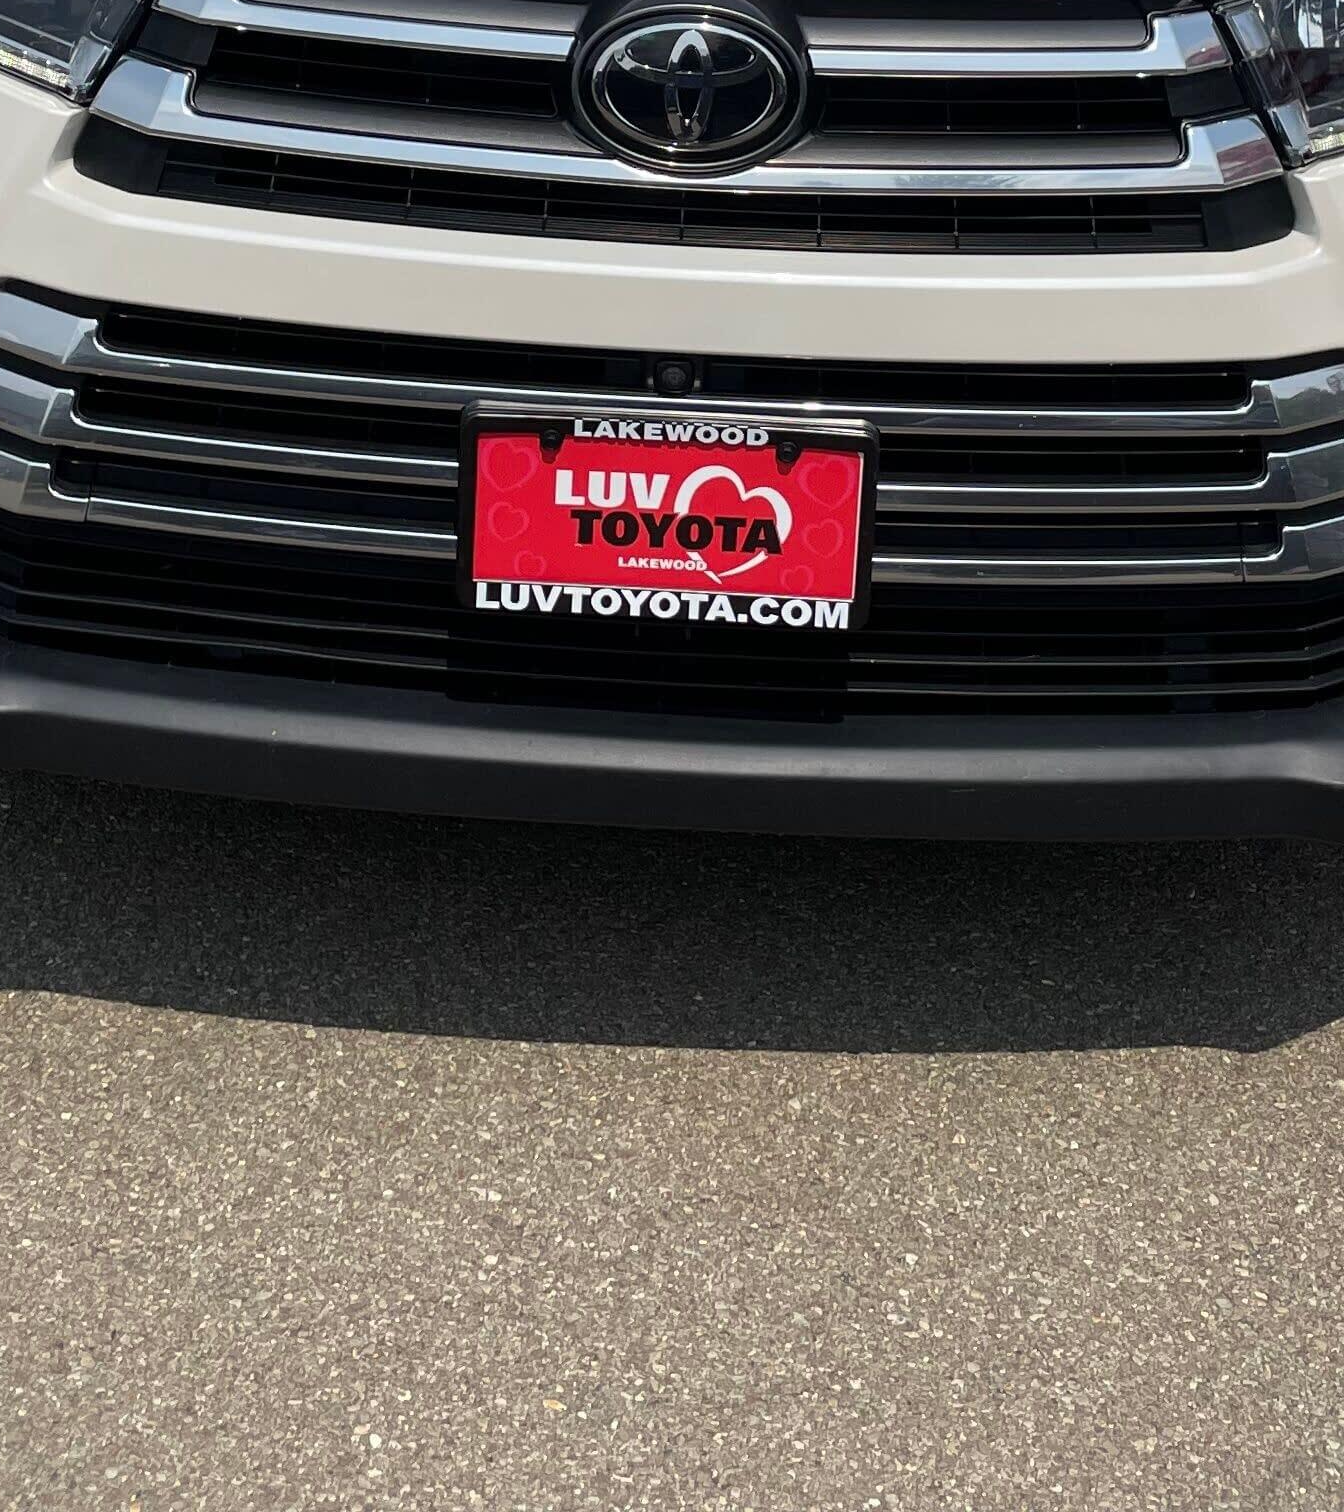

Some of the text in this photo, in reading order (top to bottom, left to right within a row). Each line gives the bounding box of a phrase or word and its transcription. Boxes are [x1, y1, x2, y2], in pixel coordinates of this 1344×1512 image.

[574, 419, 769, 446] LAKEWOOD
[555, 469, 670, 509] LUV
[571, 510, 782, 554] TOYOTA
[618, 555, 707, 571] LAKEWOOD
[475, 583, 849, 629] LUVTOYOTA.COM
